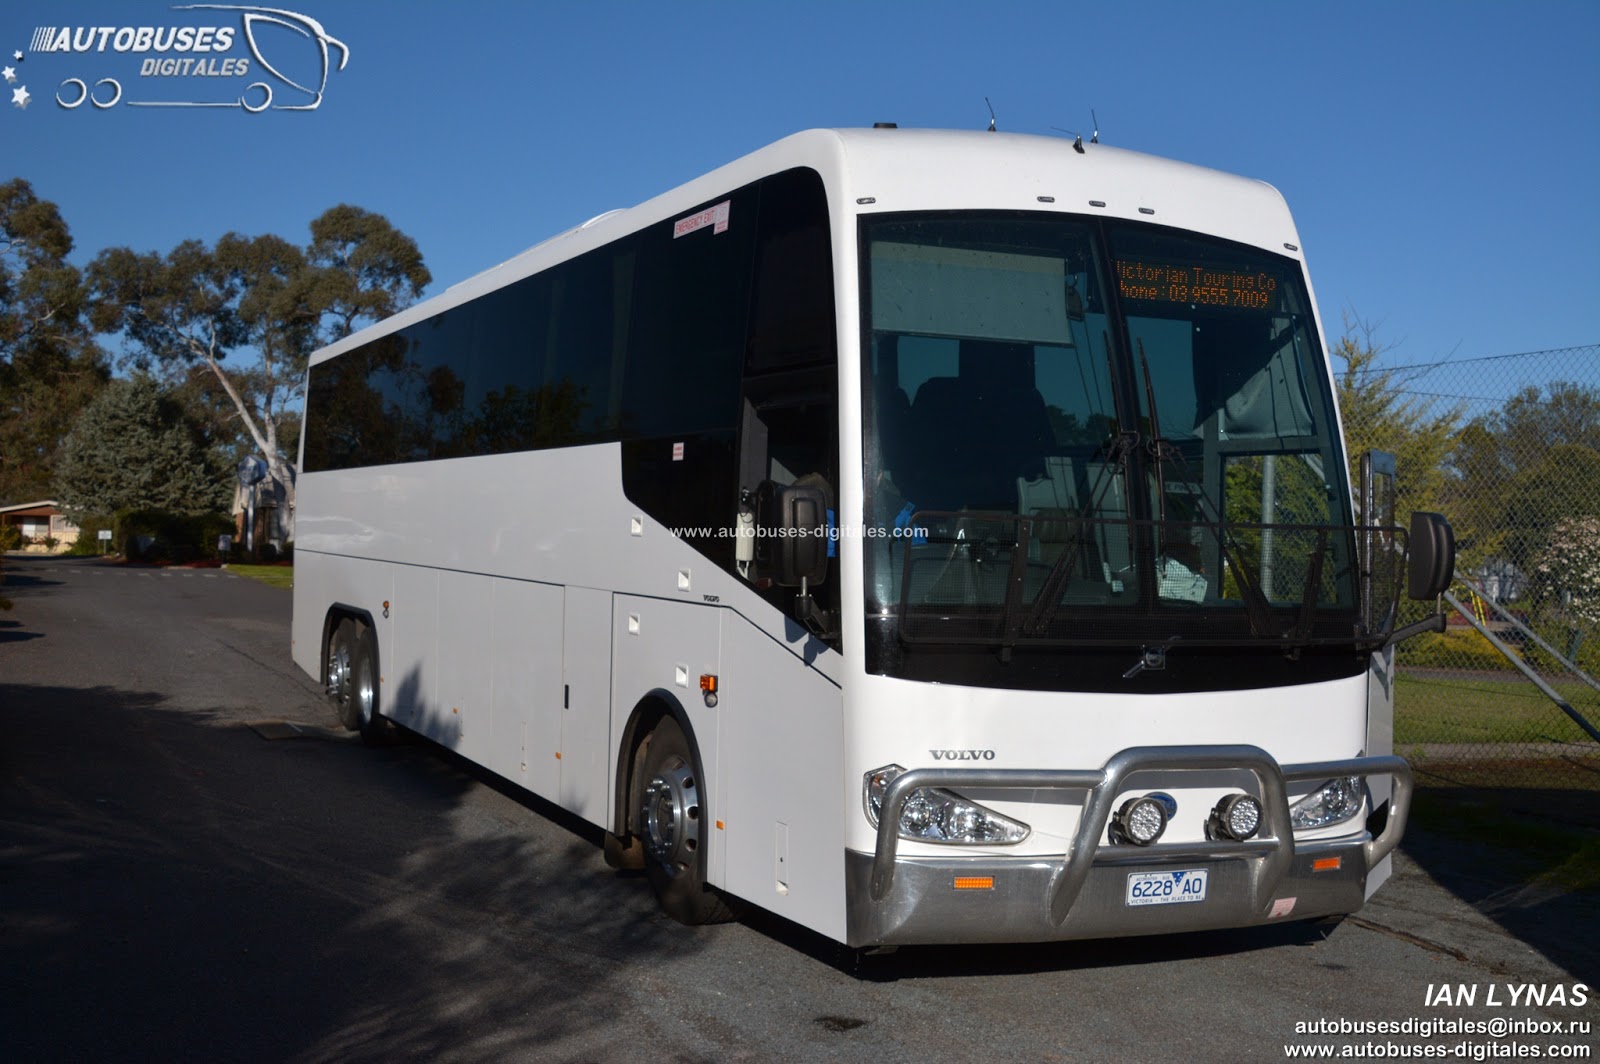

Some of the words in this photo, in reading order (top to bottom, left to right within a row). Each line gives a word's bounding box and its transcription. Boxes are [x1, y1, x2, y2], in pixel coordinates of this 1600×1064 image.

[703, 210, 715, 224] EXIT
[1193, 267, 1253, 289] Touring
[1258, 273, 1276, 291] Co
[1169, 284, 1187, 302] 03
[1192, 286, 1228, 306] 9555
[1233, 289, 1268, 308] 7009
[929, 750, 995, 760] VOLVO
[1132, 880, 1173, 898] 6228
